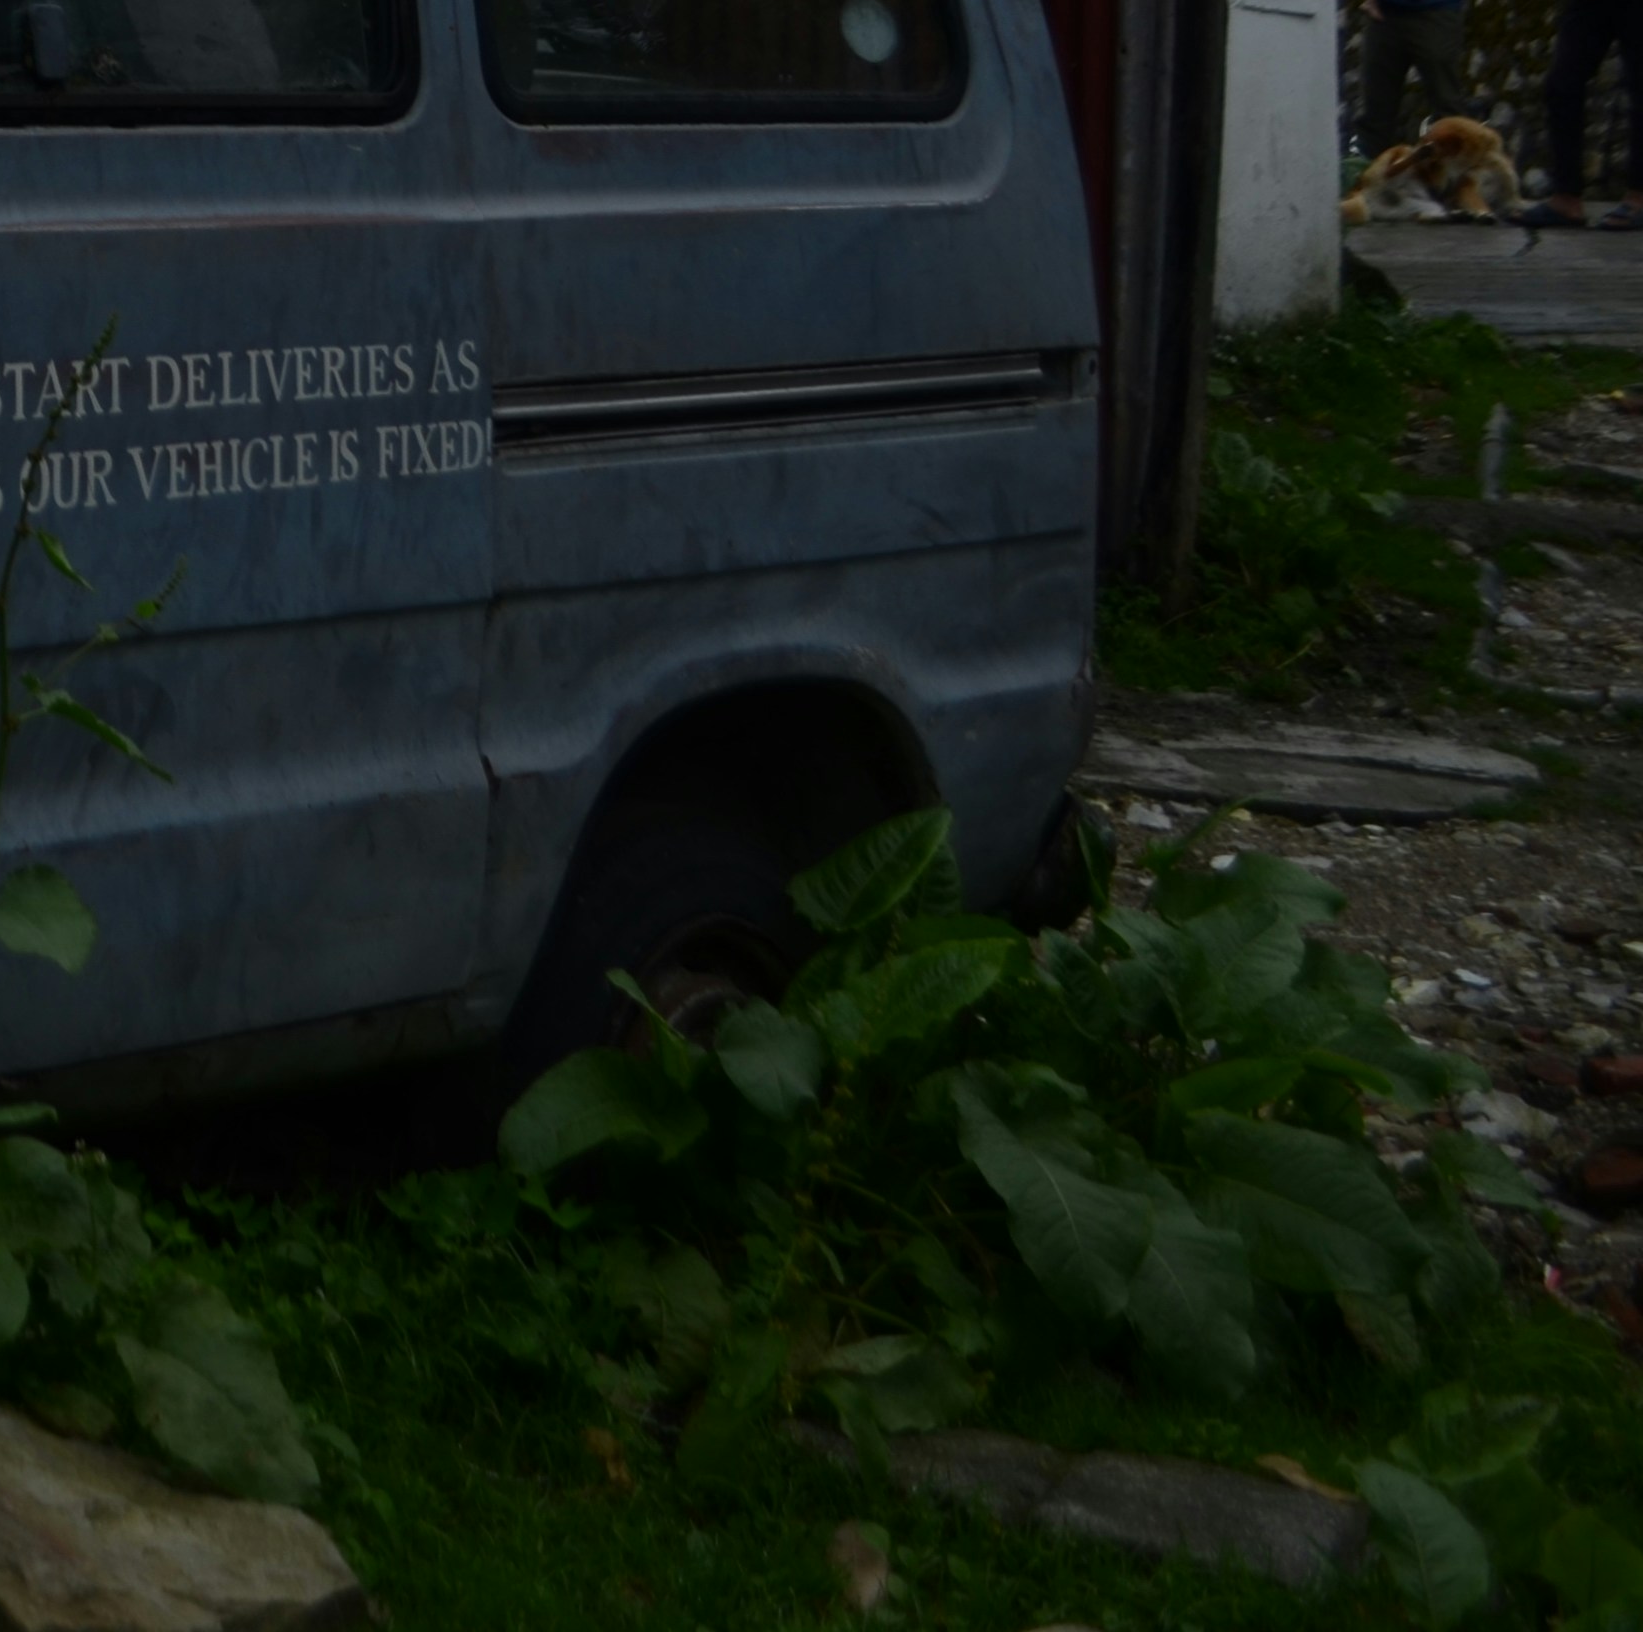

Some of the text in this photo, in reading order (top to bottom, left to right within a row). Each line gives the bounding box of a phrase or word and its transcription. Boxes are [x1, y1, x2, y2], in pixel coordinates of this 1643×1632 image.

[146, 343, 414, 412] DELIVERIES
[429, 339, 480, 395] AS
[19, 448, 117, 514] OUR
[127, 431, 319, 501] VEHICLE
[328, 428, 360, 484] IS
[376, 416, 494, 480] FIXED!
